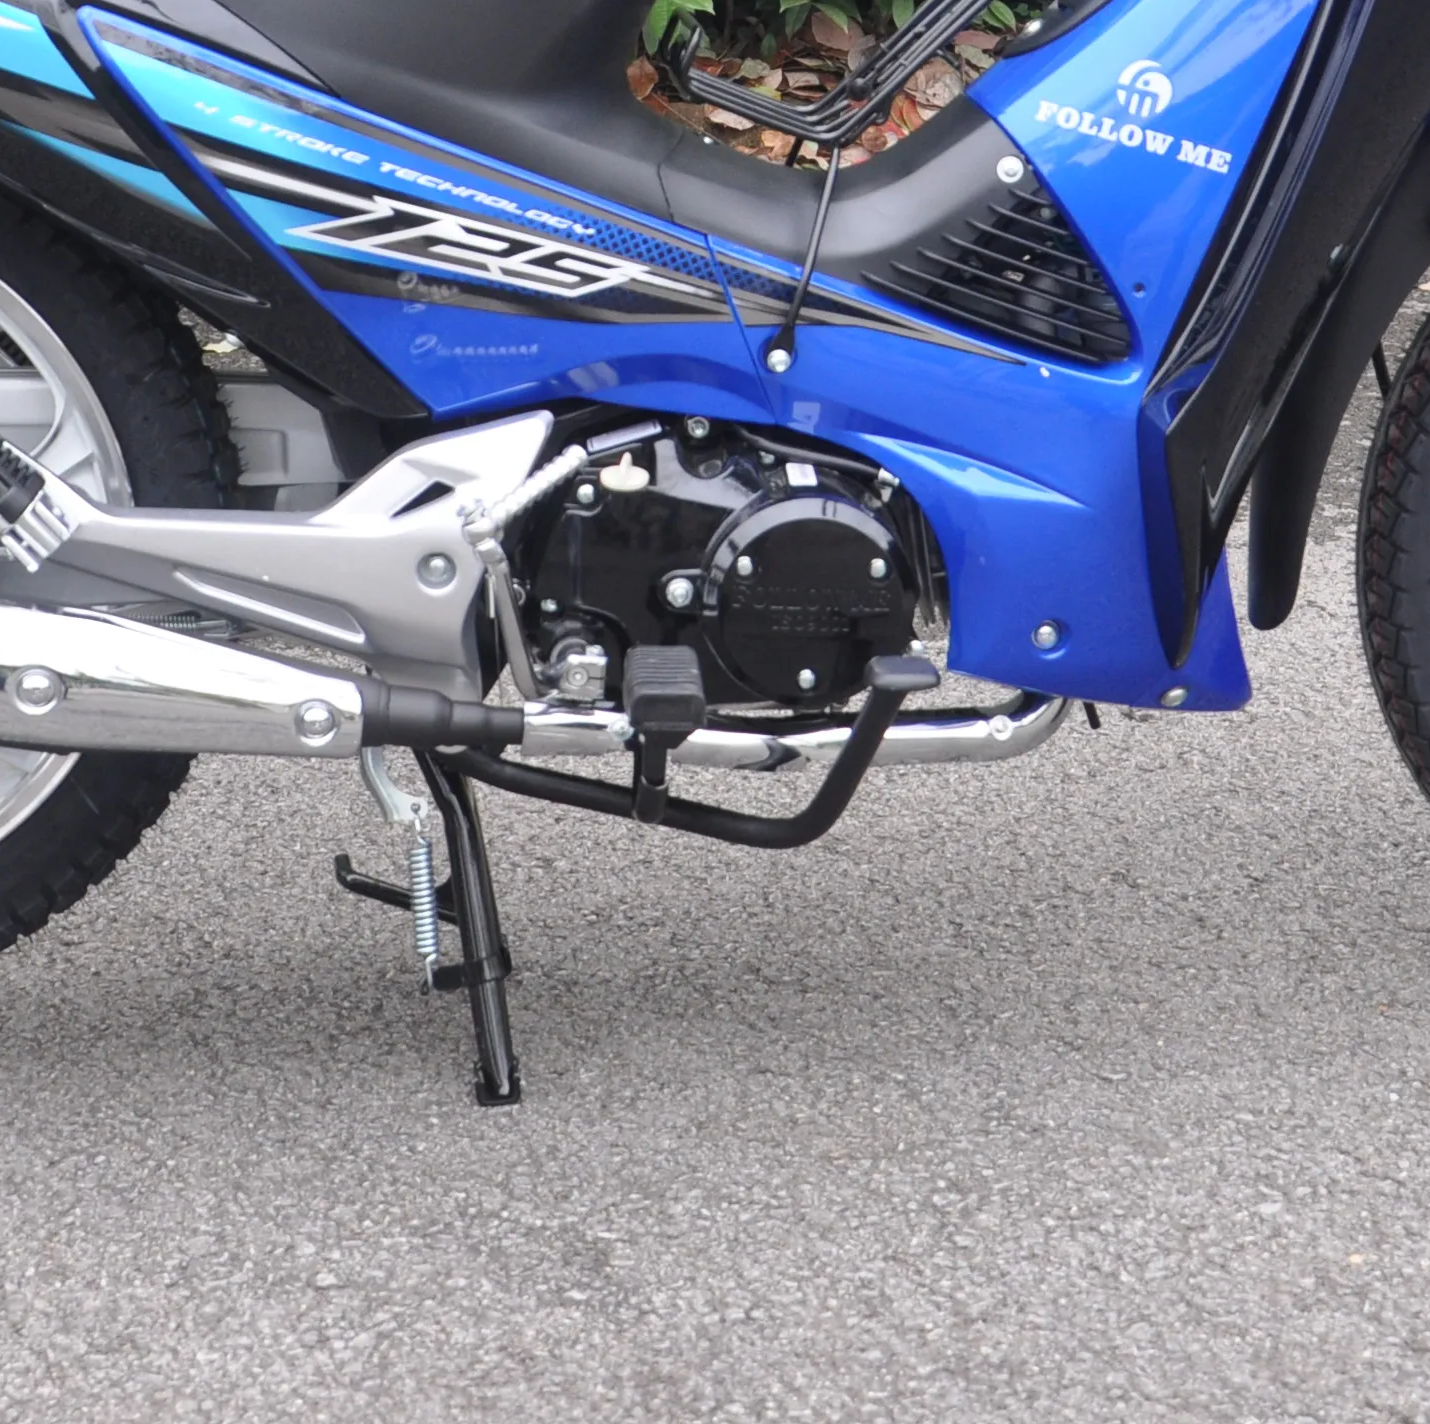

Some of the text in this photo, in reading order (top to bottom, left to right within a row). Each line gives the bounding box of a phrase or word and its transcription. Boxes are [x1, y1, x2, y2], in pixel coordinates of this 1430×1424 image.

[229, 114, 371, 165] STROKE
[379, 160, 597, 236] TECHNOLOGY
[1036, 100, 1233, 174] FOLLOW ME
